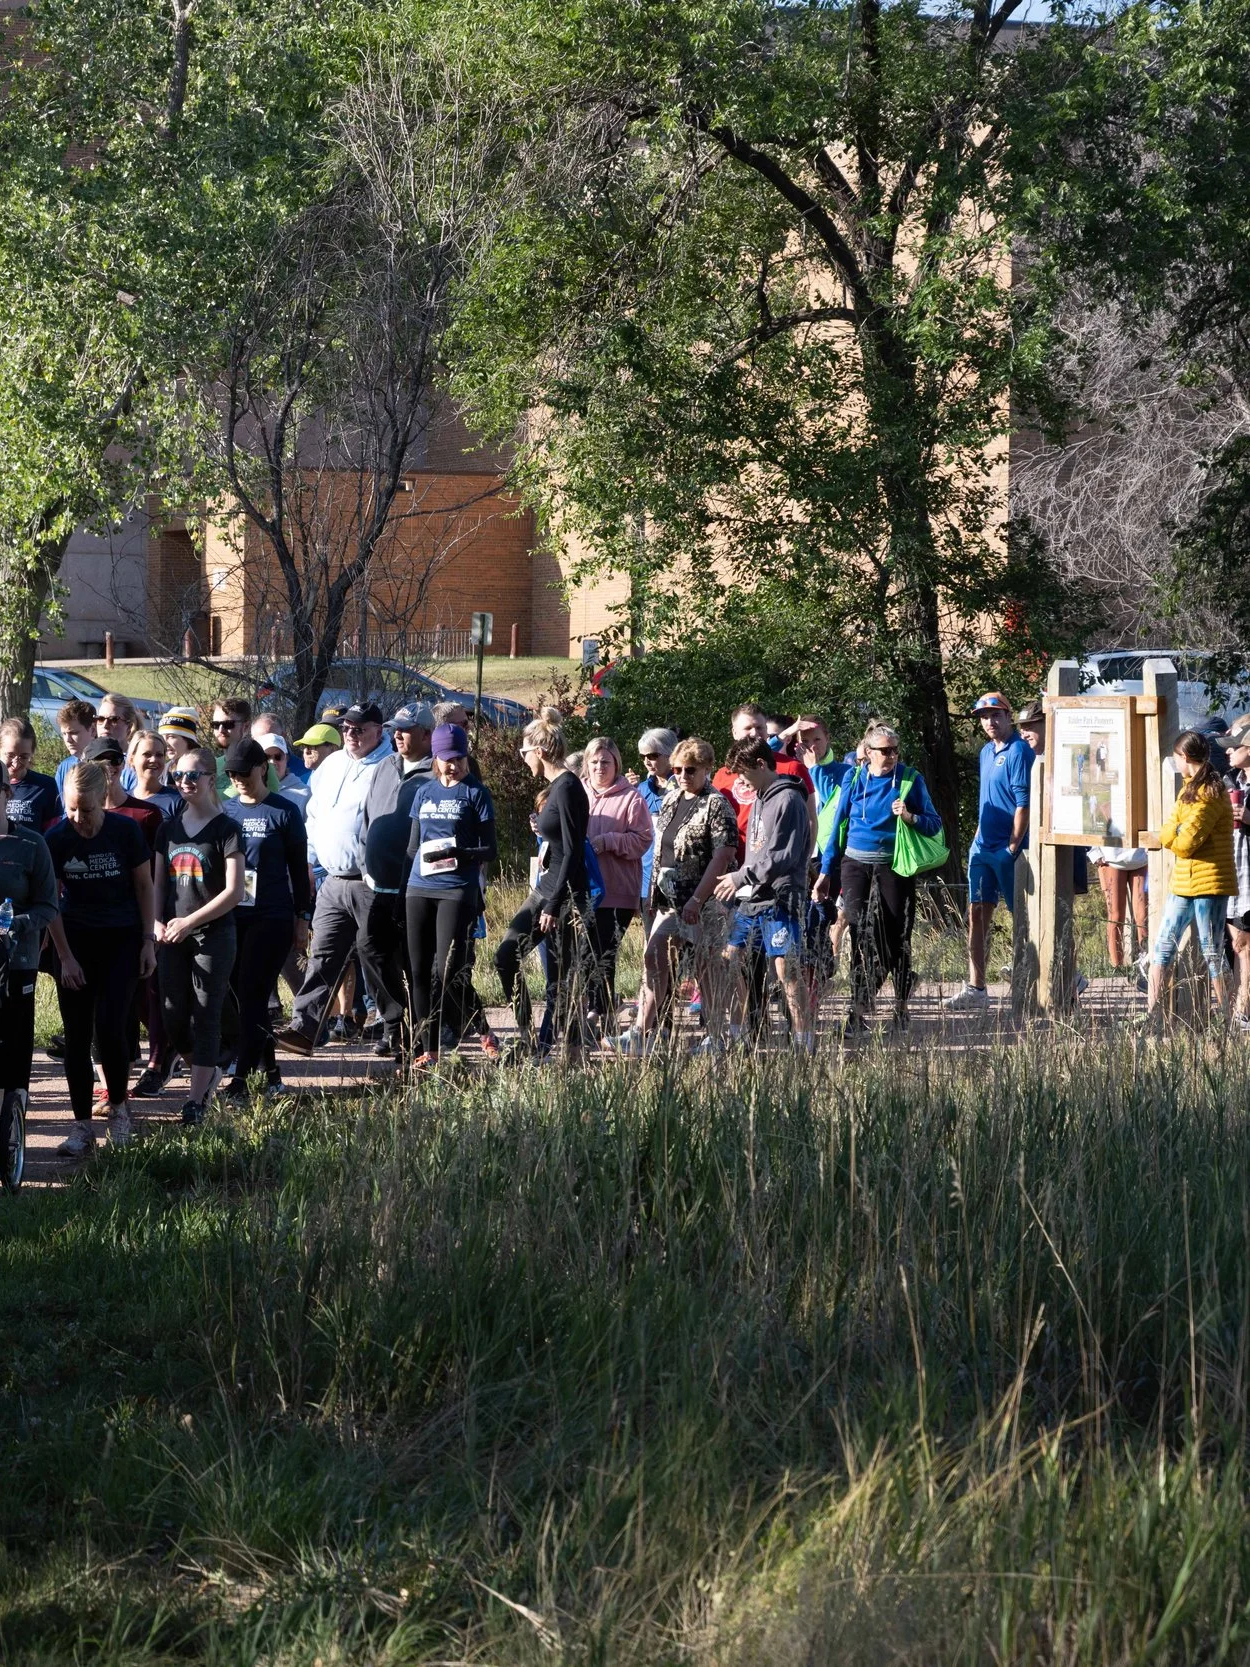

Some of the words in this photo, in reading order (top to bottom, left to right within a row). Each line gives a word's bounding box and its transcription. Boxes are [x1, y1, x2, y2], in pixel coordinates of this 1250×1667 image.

[89, 856, 117, 864] MEDICAL
[89, 862, 118, 872] CENTER
[83, 872, 103, 880] Care.
[105, 869, 121, 877] Run.
